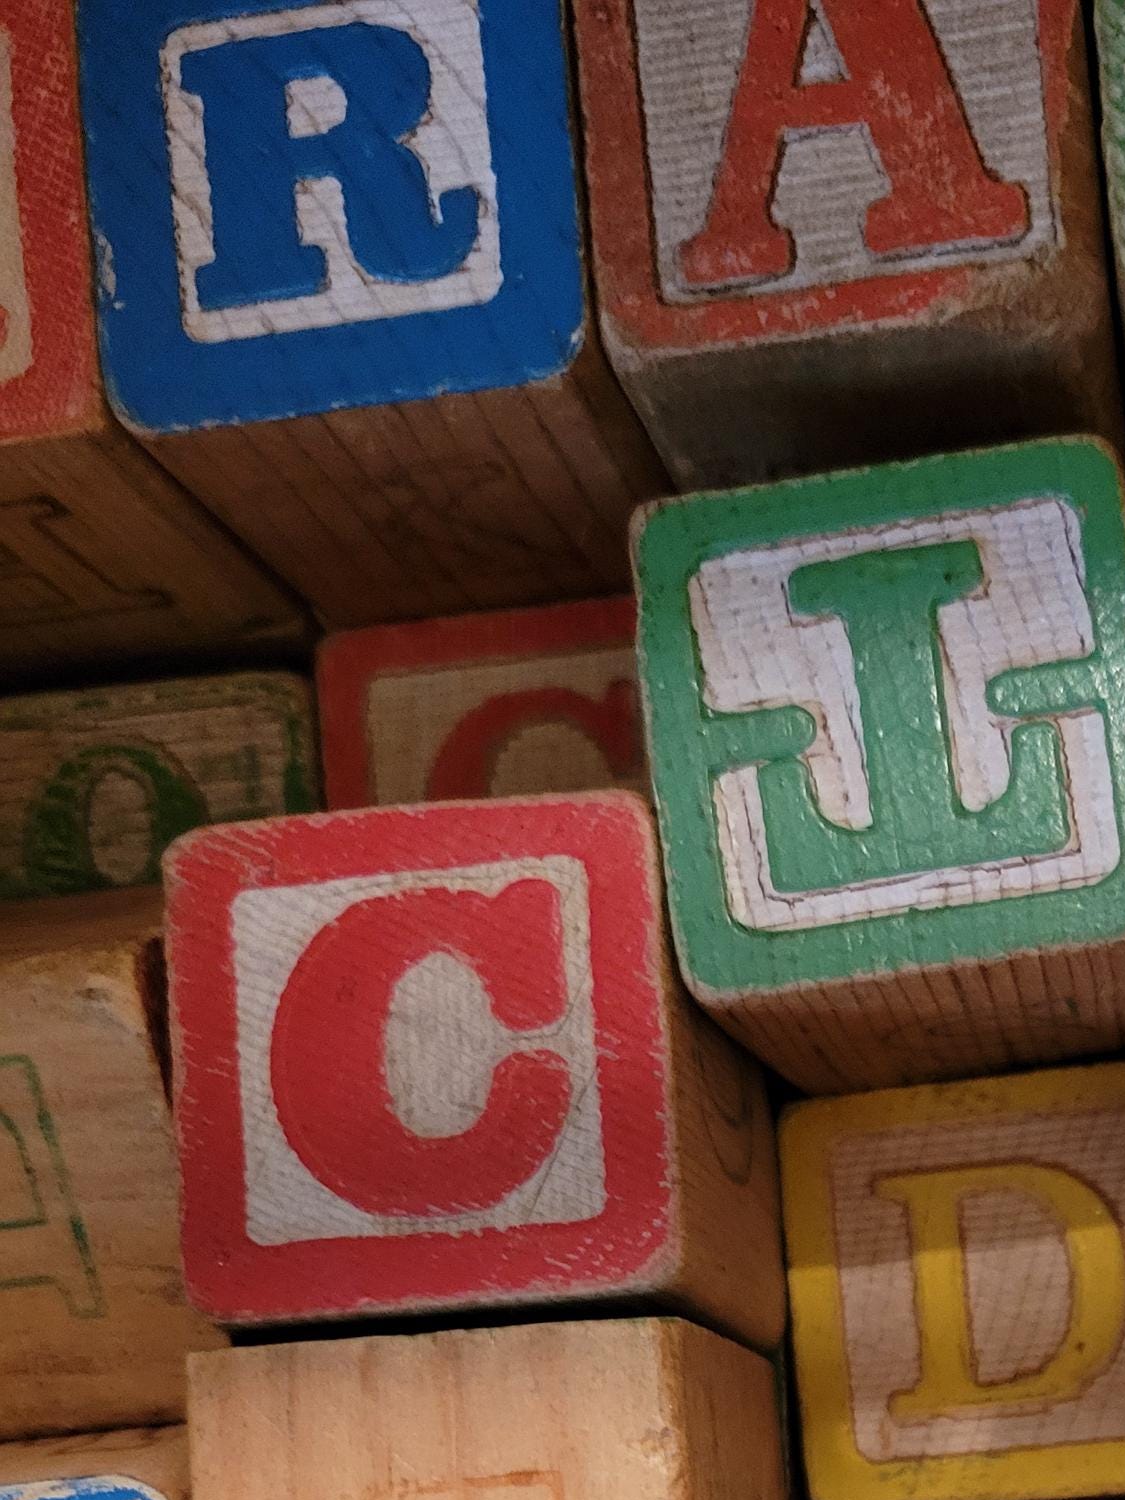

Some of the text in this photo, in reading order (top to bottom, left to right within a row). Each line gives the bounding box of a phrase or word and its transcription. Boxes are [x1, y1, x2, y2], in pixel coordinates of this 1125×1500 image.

[179, 21, 488, 310] R
[674, 0, 1030, 286] A
[270, 877, 572, 1220] C
